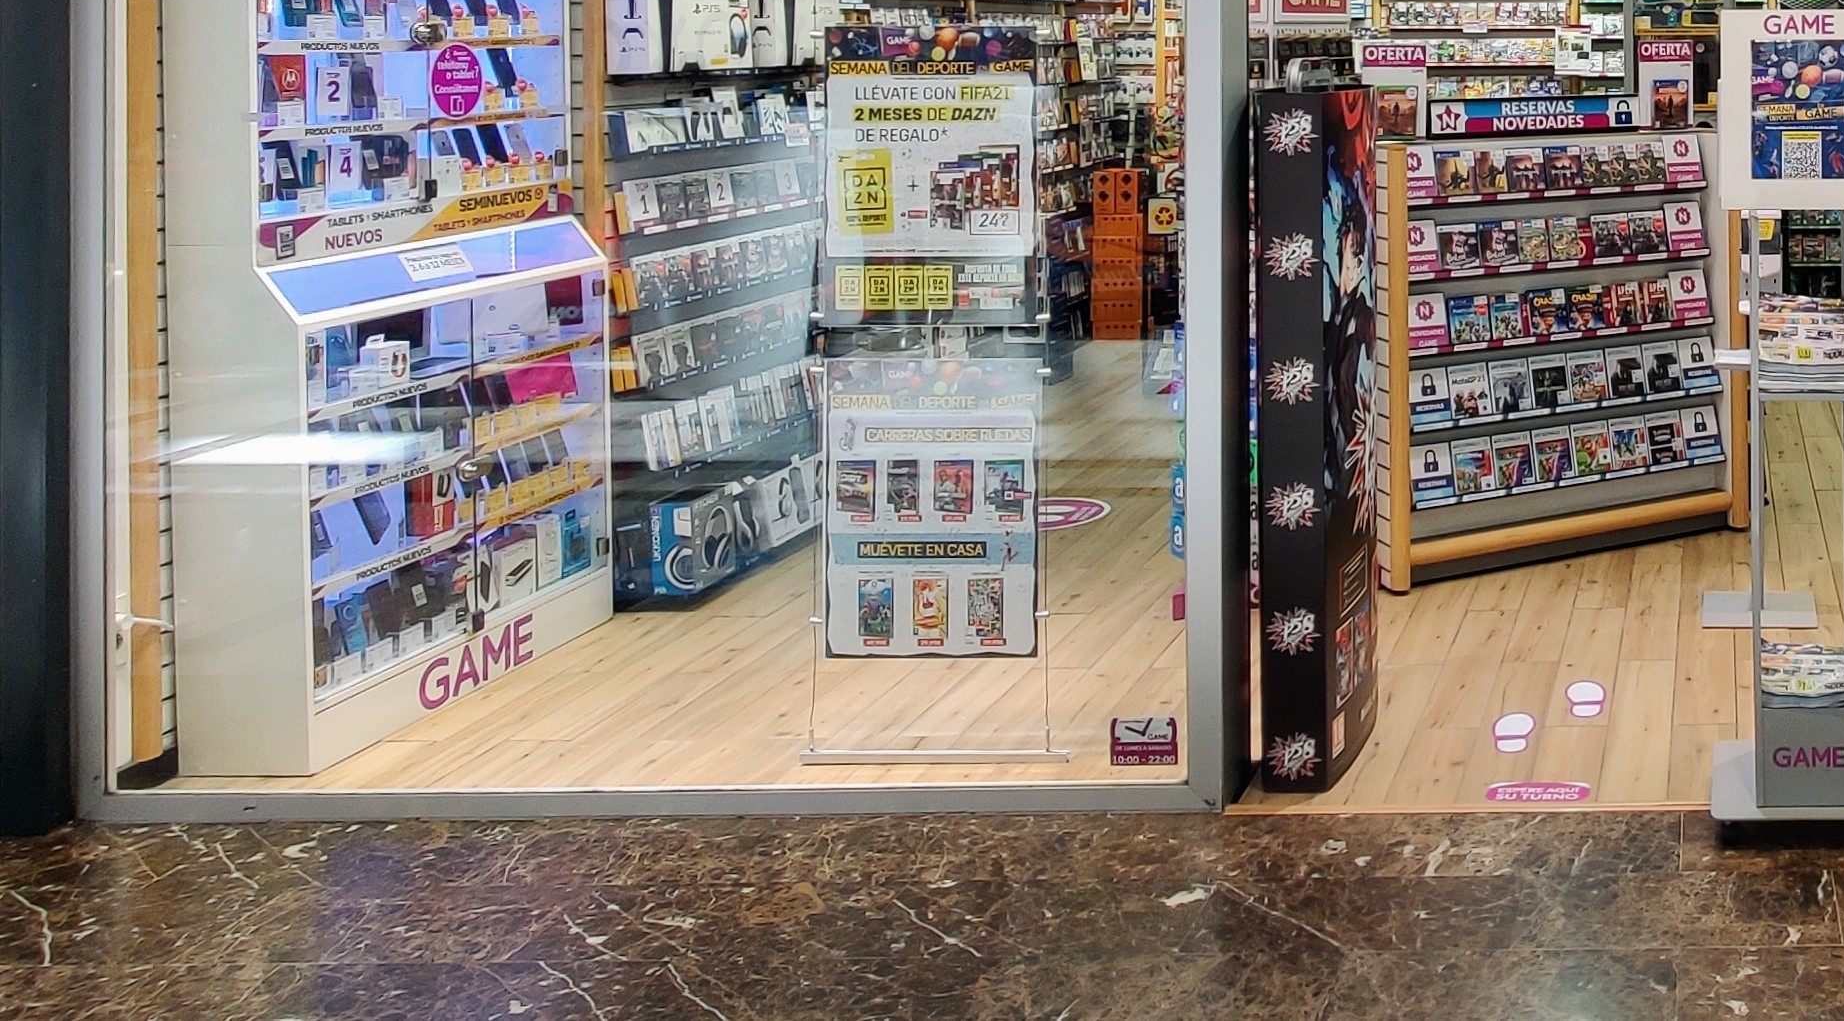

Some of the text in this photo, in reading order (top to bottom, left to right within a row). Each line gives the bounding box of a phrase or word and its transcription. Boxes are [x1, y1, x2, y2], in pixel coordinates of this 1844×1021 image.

[1763, 14, 1835, 35] GAME
[301, 42, 348, 51] PRODUCTOS
[1365, 46, 1424, 61] OFERTA
[1640, 43, 1691, 56] OFERTA
[830, 61, 1031, 74] SEMANA DEL DEPORTE GAME
[327, 80, 341, 103] 2
[855, 85, 1010, 101] LLÉVATE CON FIFA21
[855, 108, 996, 121] 2 MESES DE DAZN
[1501, 100, 1575, 115] RESERVAS
[1805, 108, 1838, 119] GAME
[1492, 114, 1585, 131] NOVEDADES
[856, 129, 876, 142] DE
[339, 155, 353, 178] 4
[852, 175, 878, 187] DA
[459, 189, 532, 212] SEMINUEVOS
[853, 191, 878, 204] ZN
[327, 204, 434, 228] TABLETS SMARTPHONES
[325, 230, 383, 250] NUEVOS
[832, 397, 888, 409] SEMANA
[919, 397, 976, 409] DEPORTE
[866, 429, 1031, 442] CARRERAS SOBRE RUEDAS
[859, 541, 985, 557] MUÉVETE EN CASA
[356, 560, 402, 581] PRODUCTOS
[419, 614, 535, 710] GAME
[1113, 755, 1176, 765] 10:00 22:00
[1496, 793, 1579, 801] SU TURNO
[1498, 786, 1543, 794] ESPERE
